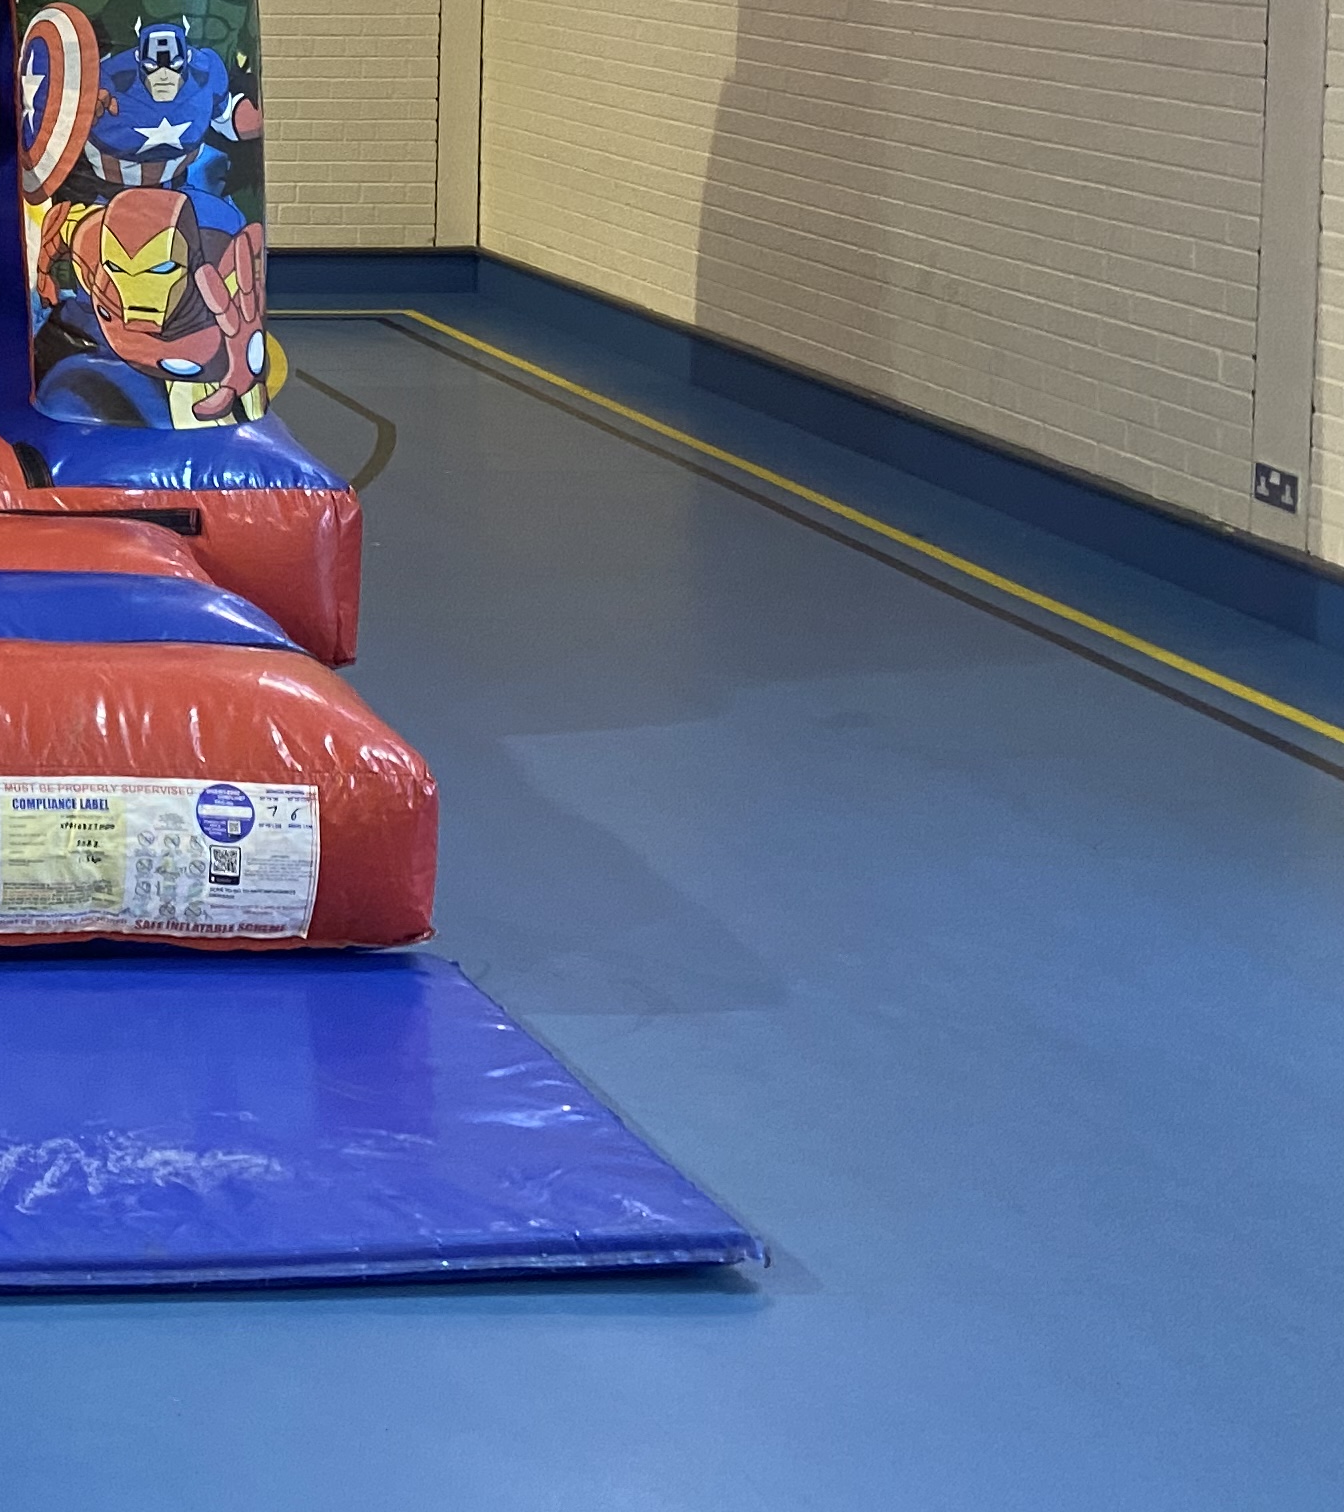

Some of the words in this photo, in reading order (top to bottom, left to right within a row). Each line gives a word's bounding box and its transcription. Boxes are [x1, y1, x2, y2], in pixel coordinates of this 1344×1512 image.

[3, 782, 34, 793] MUST
[39, 783, 55, 793] BE
[57, 784, 118, 794] PROPERLY
[121, 784, 194, 795] SUPERVISED
[12, 798, 77, 810] COMPLIANCE
[79, 798, 109, 810] LABEL
[134, 919, 163, 931] SAFE
[165, 920, 235, 933] INFLATABLE
